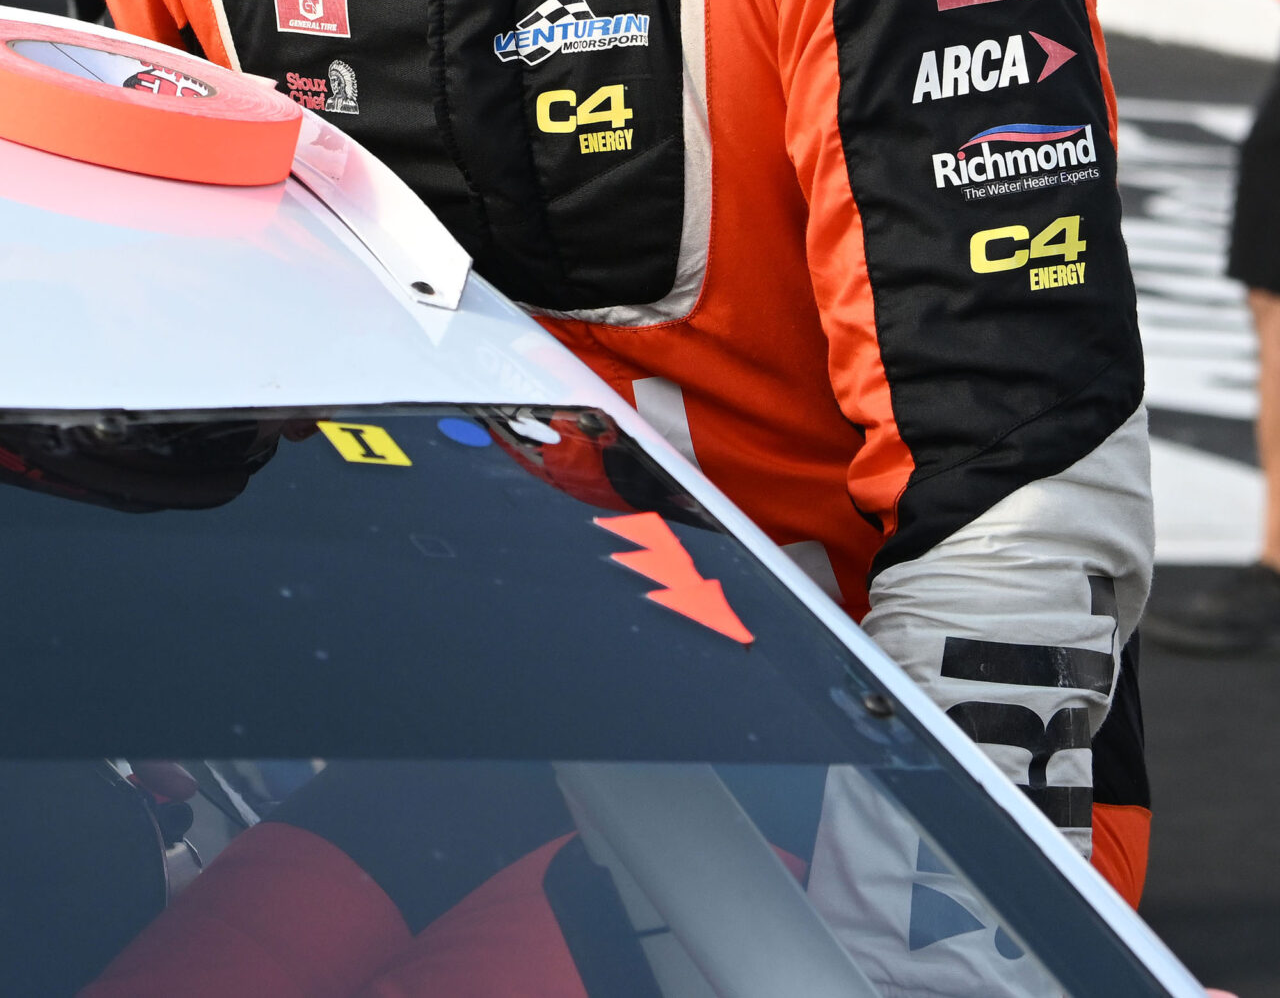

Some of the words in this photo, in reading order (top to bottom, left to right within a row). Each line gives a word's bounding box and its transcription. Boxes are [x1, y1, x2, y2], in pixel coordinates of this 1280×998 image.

[285, 71, 328, 93] Sioux
[911, 33, 1030, 104] ARCA
[535, 83, 634, 134] C4
[578, 128, 634, 155] ENERGY
[931, 123, 1098, 190] Richmond
[964, 187, 987, 201] The
[987, 181, 1021, 197] Water
[1023, 174, 1059, 190] Heater
[1060, 167, 1100, 185] Experts
[969, 214, 1087, 275] C4
[1028, 262, 1087, 291] ENERGY
